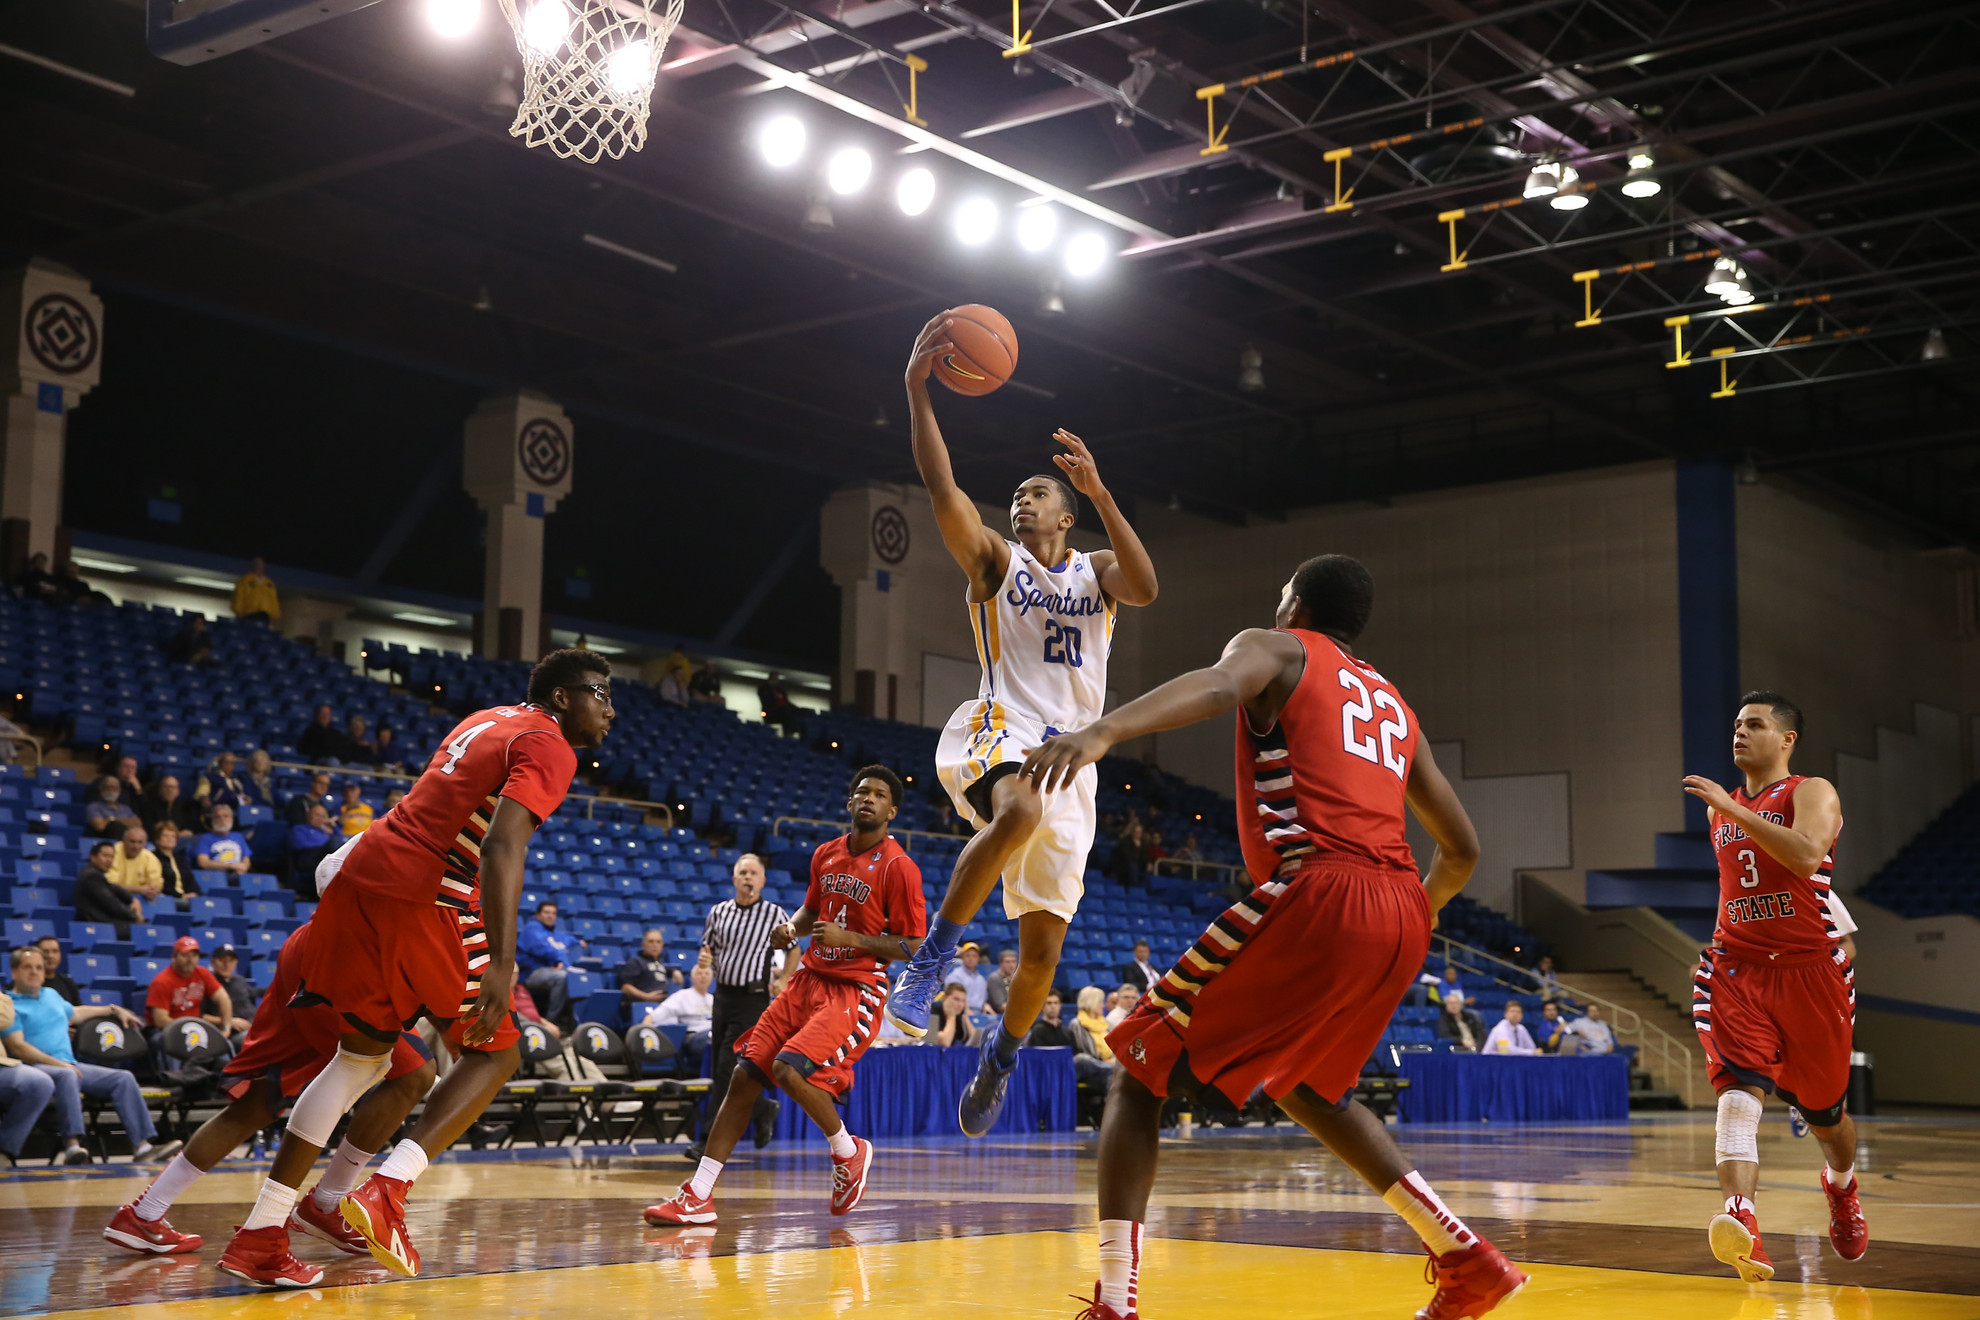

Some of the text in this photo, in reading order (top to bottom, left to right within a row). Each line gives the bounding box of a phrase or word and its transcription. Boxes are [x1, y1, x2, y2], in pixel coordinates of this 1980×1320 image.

[1006, 570, 1103, 616] Spartans
[1043, 618, 1083, 668] 20
[440, 720, 498, 775] 4
[1337, 667, 1408, 782] 22
[820, 873, 871, 904] FRESNO
[1737, 848, 1760, 889] 3
[1726, 891, 1795, 925] STATE
